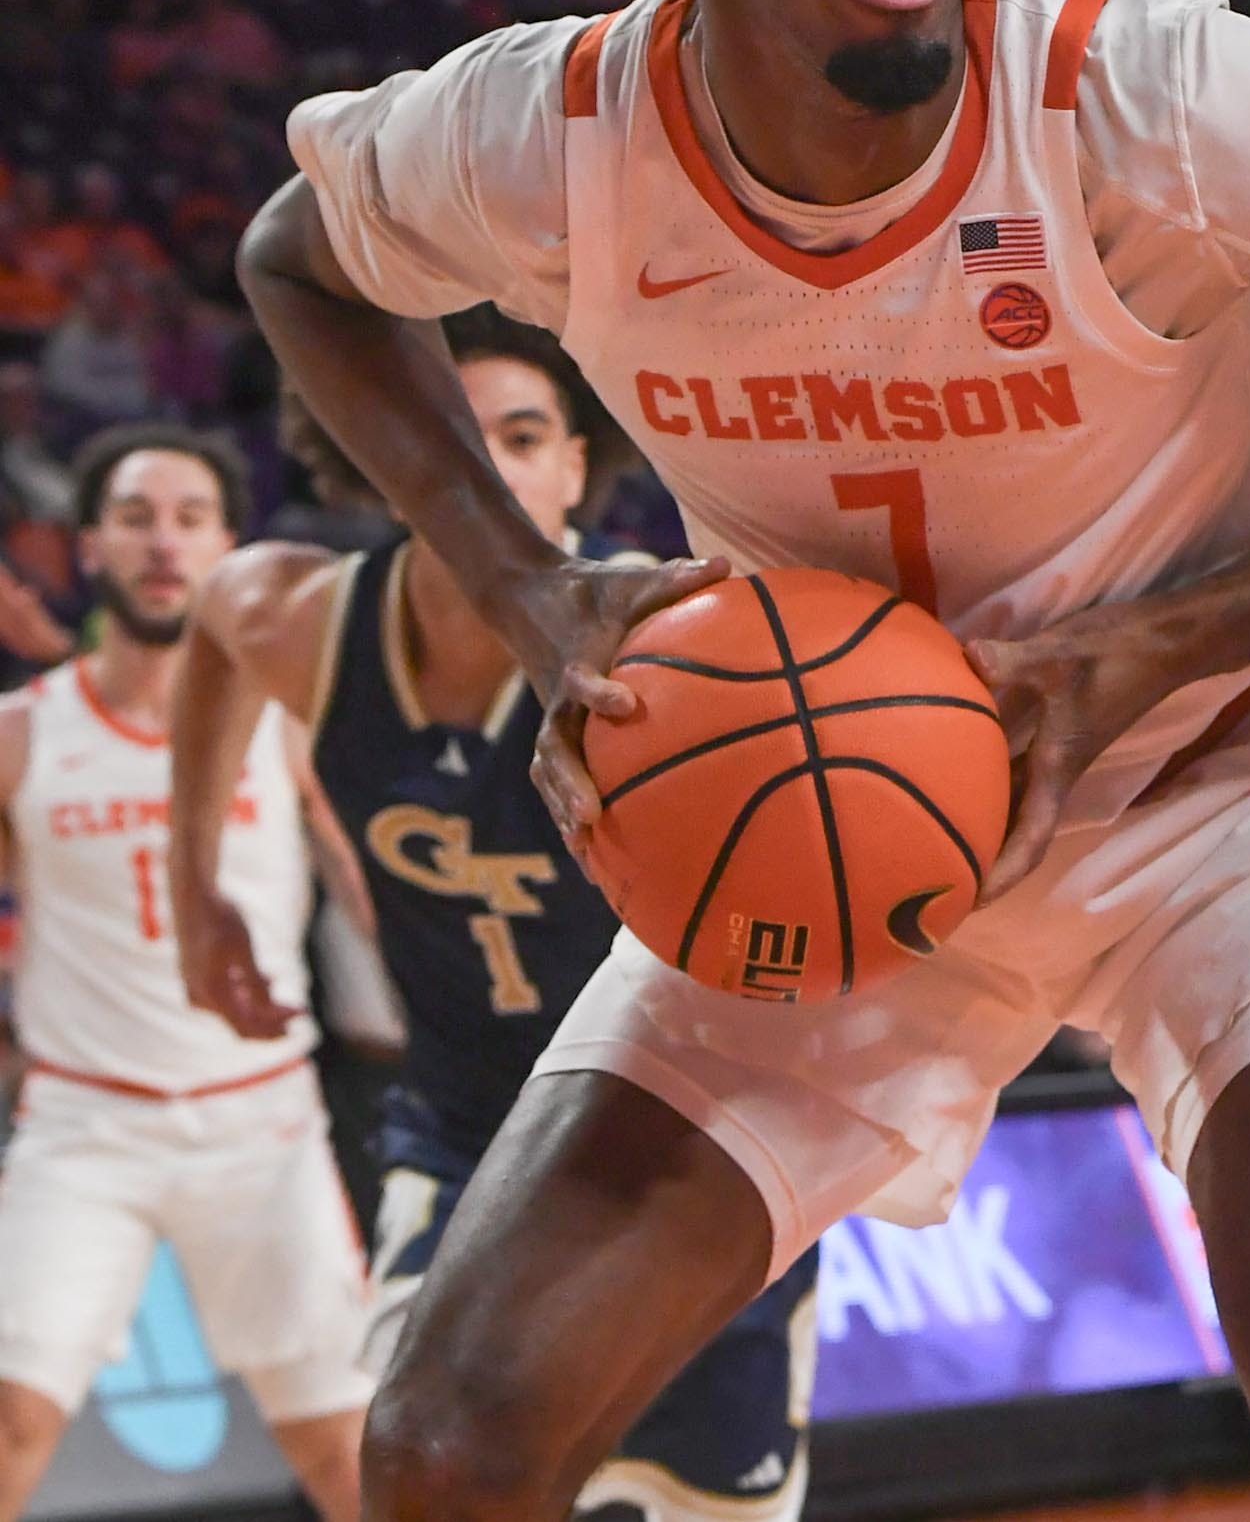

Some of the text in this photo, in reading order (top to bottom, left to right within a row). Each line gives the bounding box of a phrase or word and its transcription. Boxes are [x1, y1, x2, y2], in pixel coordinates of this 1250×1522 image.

[990, 304, 1046, 323] ACC
[634, 364, 1082, 442] CLEMSON
[830, 468, 938, 621] 7
[131, 846, 162, 941] 1
[365, 803, 558, 916] GT
[470, 914, 542, 1014] 1
